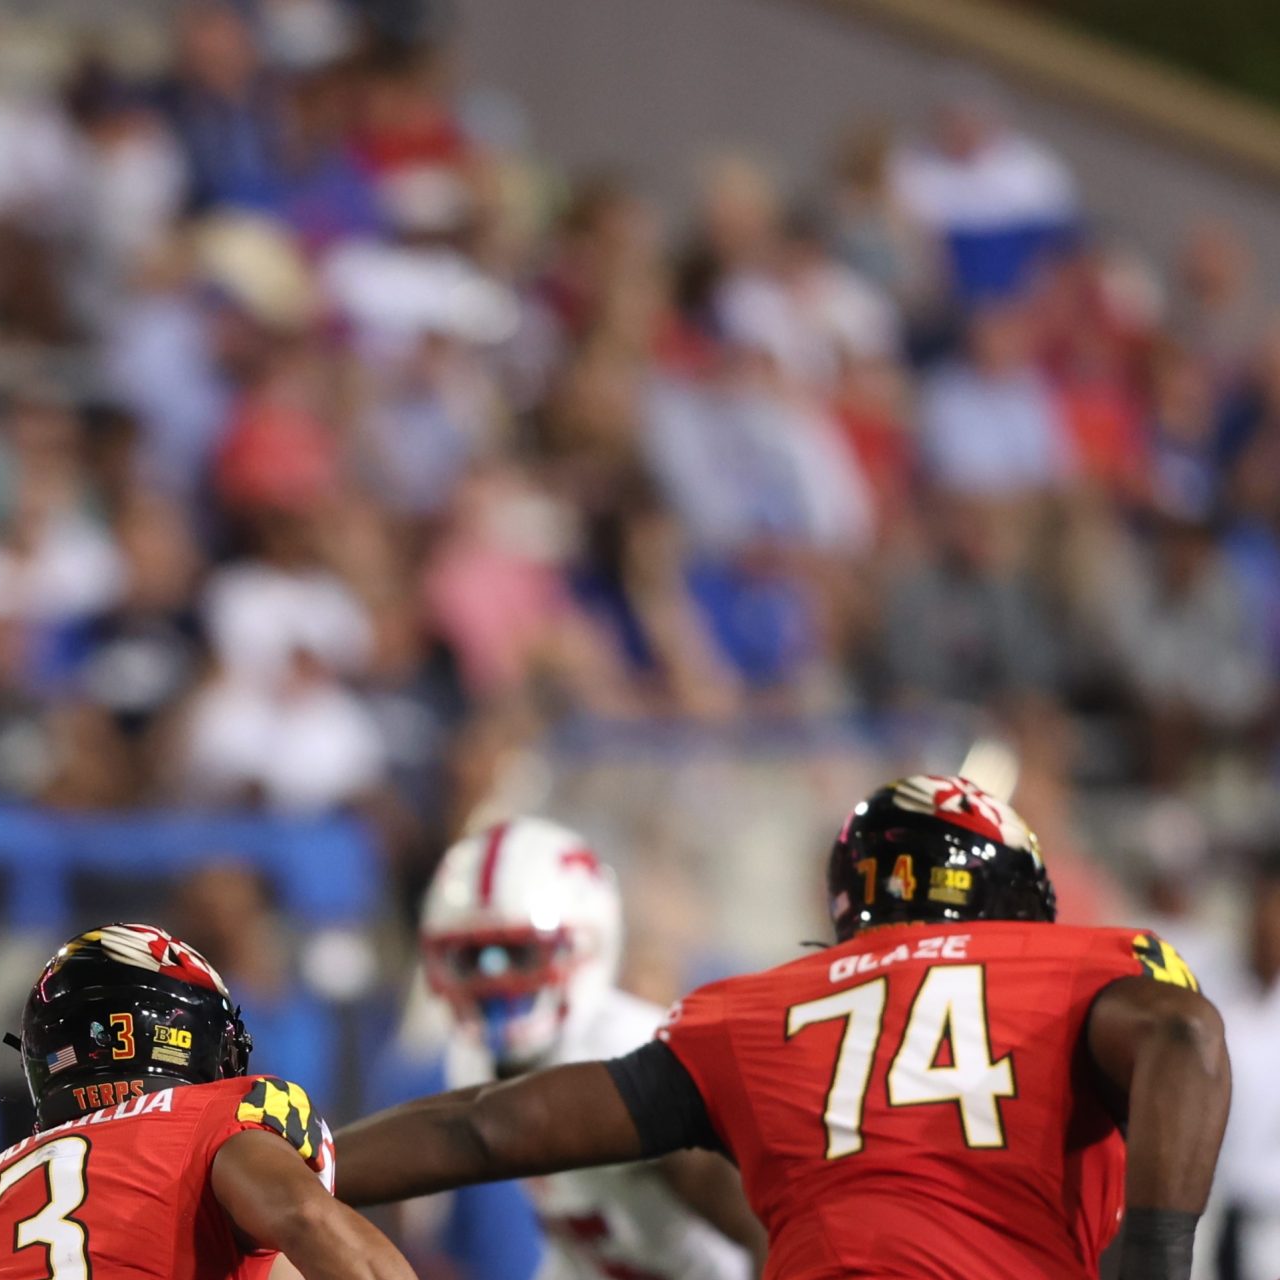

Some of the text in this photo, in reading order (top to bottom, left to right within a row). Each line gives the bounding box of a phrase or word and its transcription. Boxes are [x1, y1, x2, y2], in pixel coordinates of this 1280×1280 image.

[829, 934, 972, 983] GLAZE
[109, 1012, 136, 1060] 3
[784, 963, 1018, 1161] 74
[73, 1080, 144, 1110] TERPS
